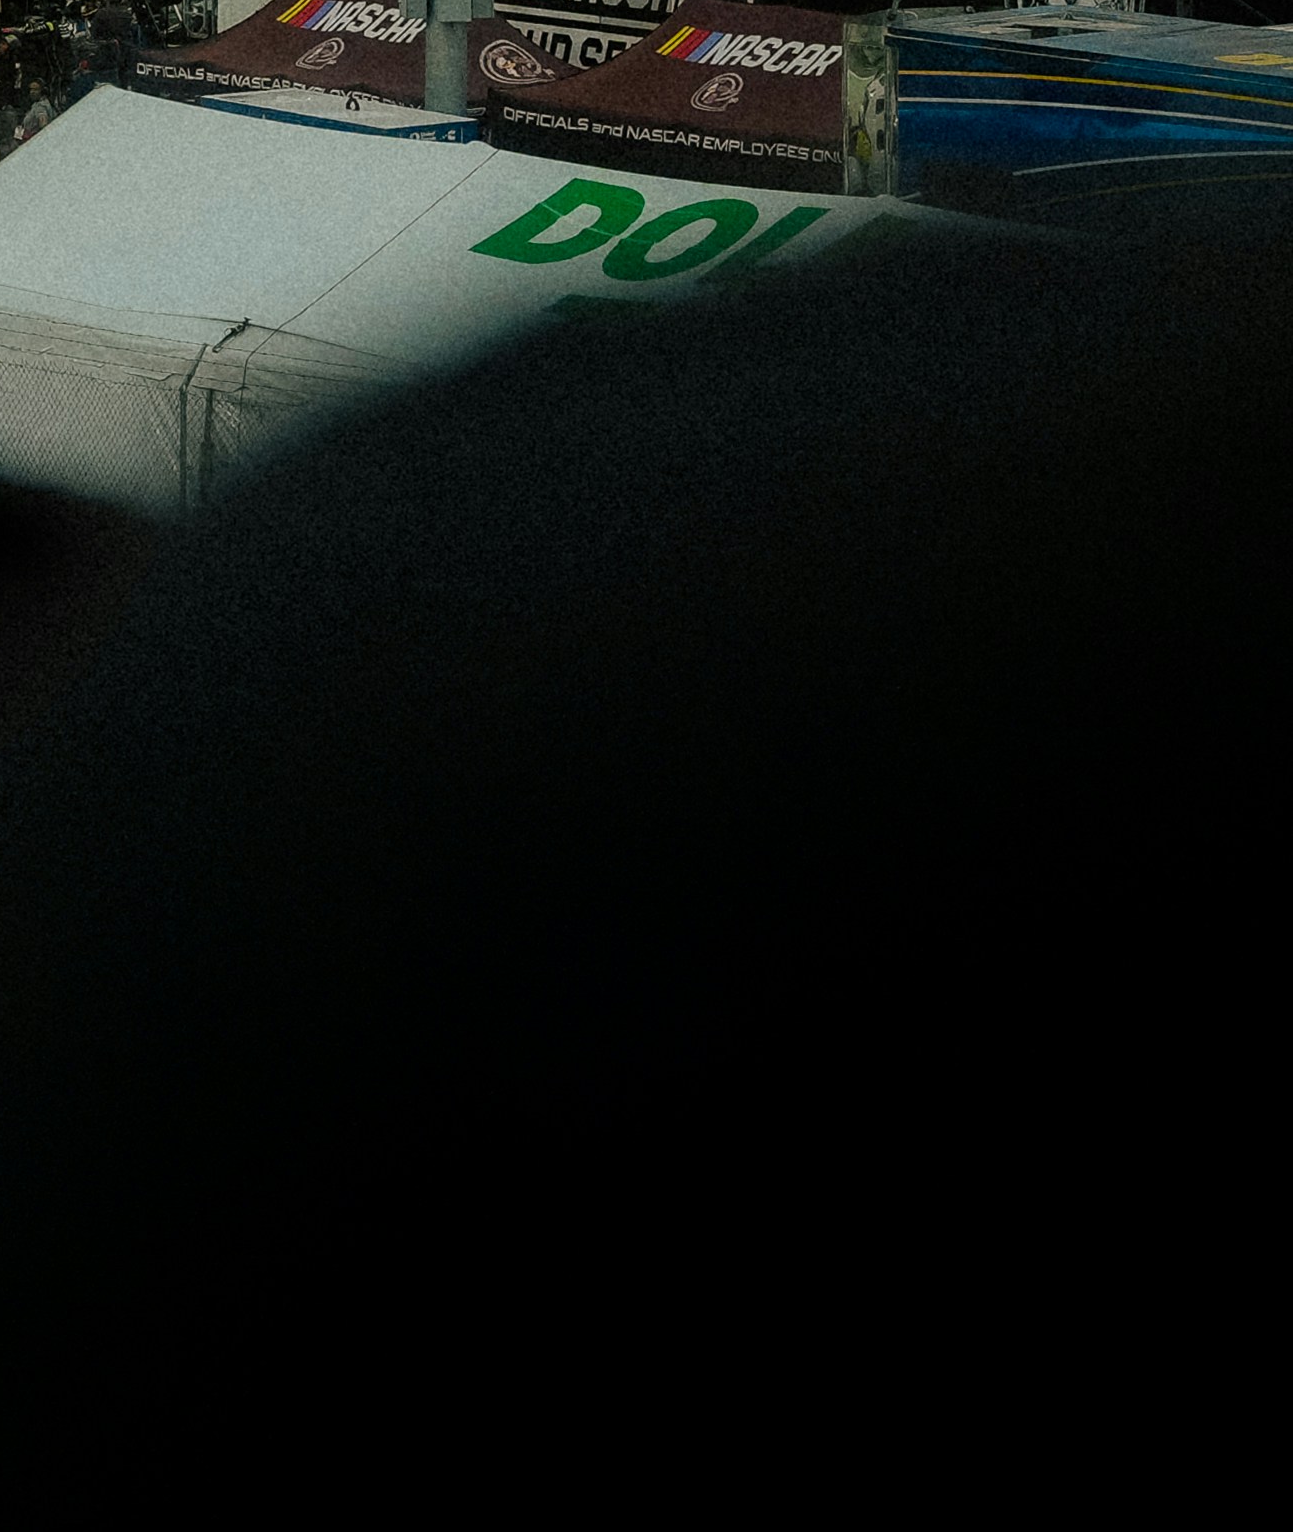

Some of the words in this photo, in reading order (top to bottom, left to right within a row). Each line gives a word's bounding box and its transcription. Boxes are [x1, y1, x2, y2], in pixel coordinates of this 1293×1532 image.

[136, 61, 204, 81] OFFICIALS
[206, 71, 229, 86] and
[699, 33, 843, 77] NASCAR
[503, 105, 589, 132] OFFICIALS
[591, 122, 624, 137] and
[626, 125, 700, 147] NASCAR
[702, 136, 809, 160] EMPLOYEES
